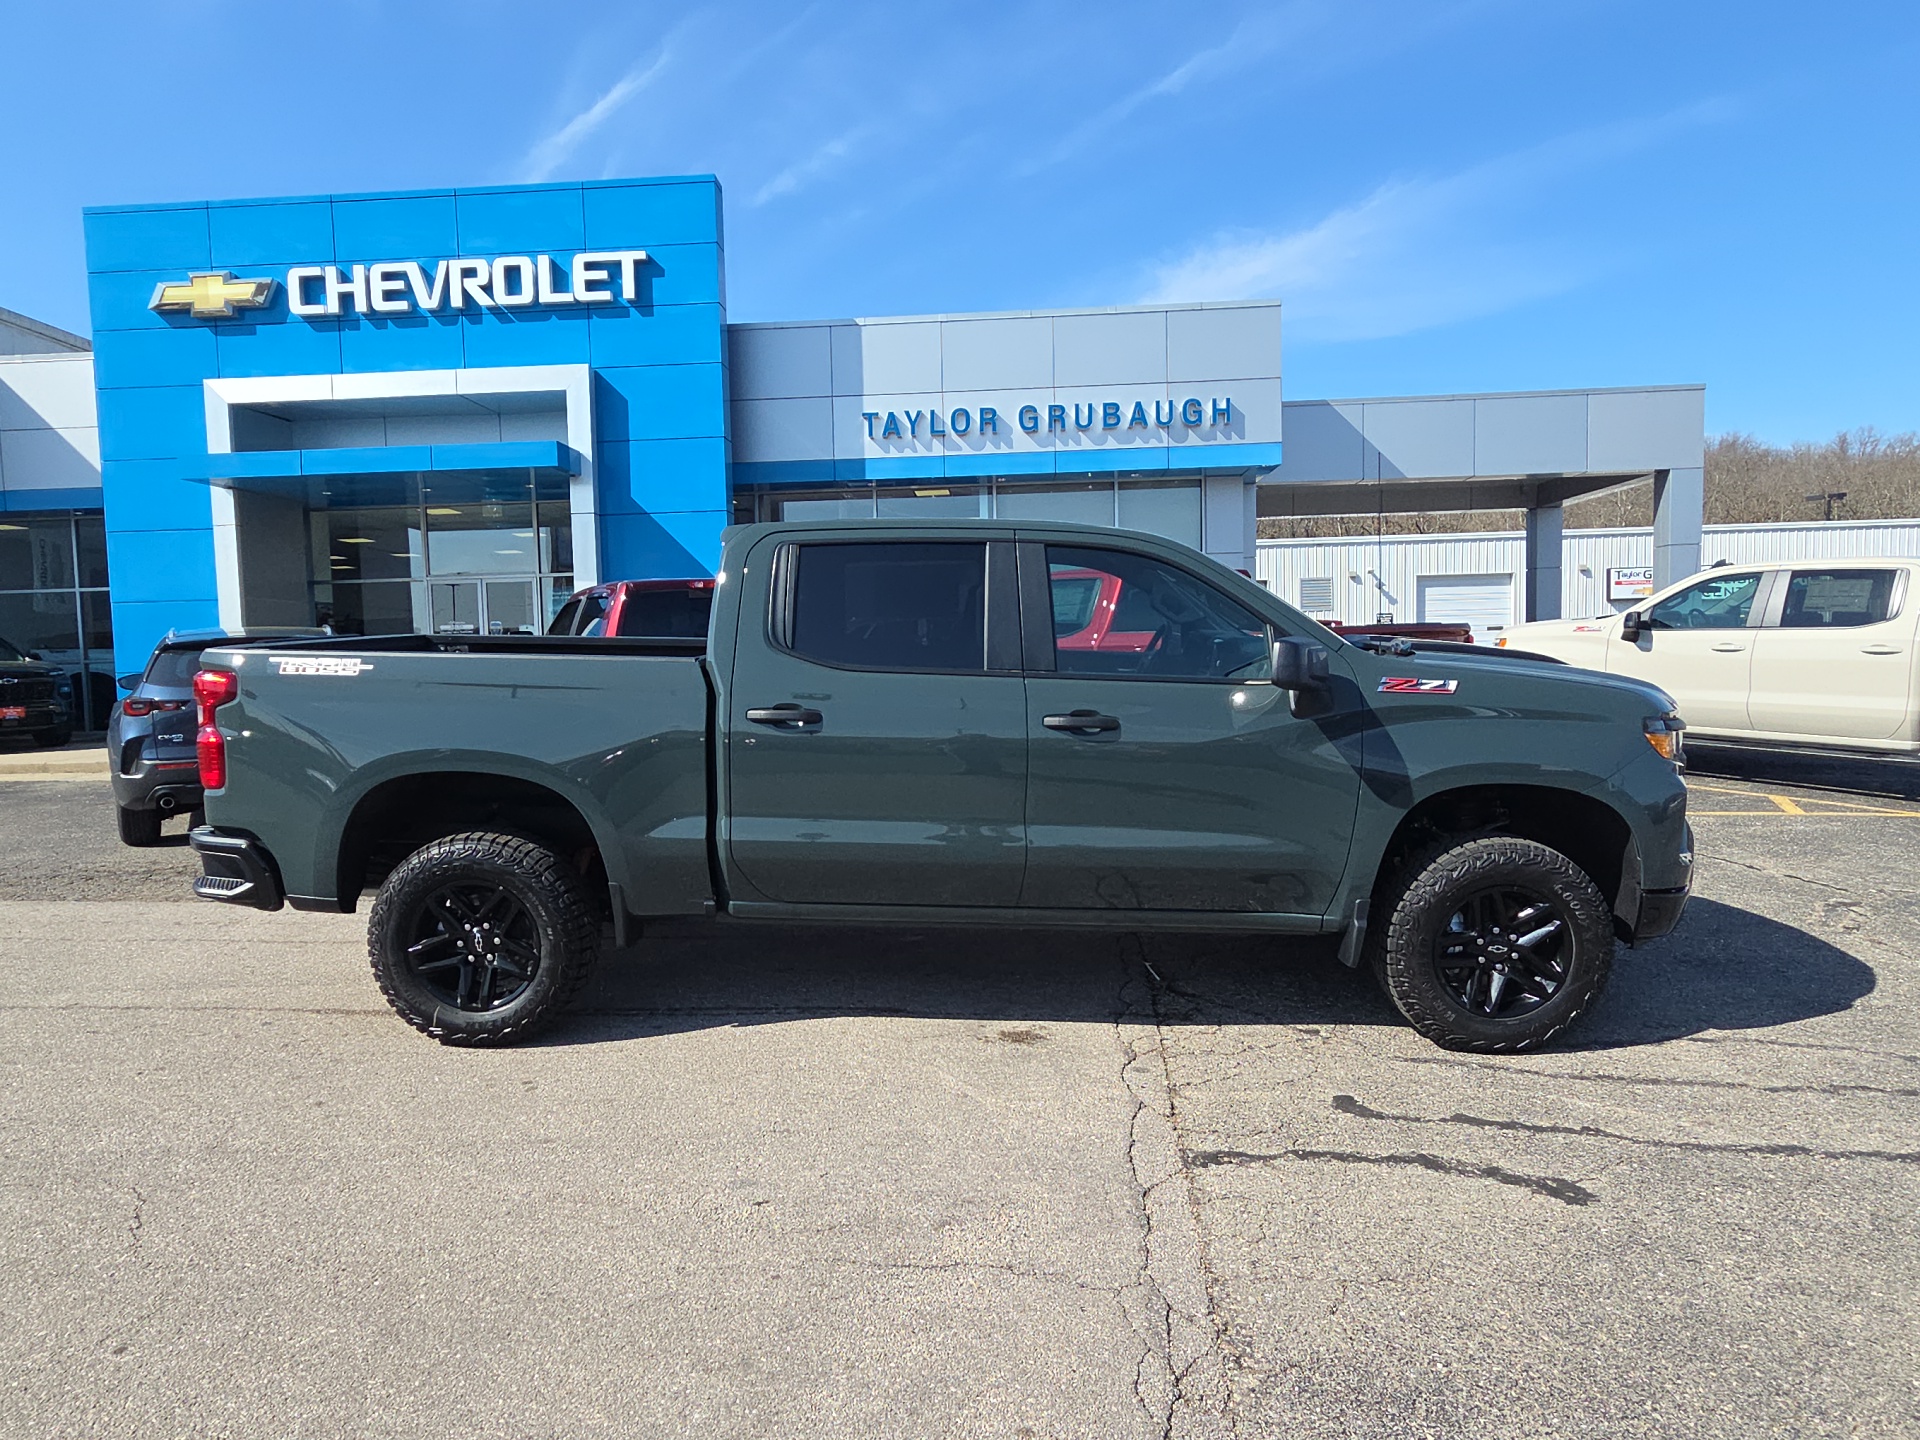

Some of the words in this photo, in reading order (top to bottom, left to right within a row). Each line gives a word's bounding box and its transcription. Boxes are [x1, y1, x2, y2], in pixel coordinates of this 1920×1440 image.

[286, 250, 647, 315] CHEVROLET
[862, 406, 998, 439] TAYLOR
[1017, 397, 1233, 433] GRUBAUGH
[279, 665, 360, 676] BOSS
[1377, 676, 1459, 695] Z71
